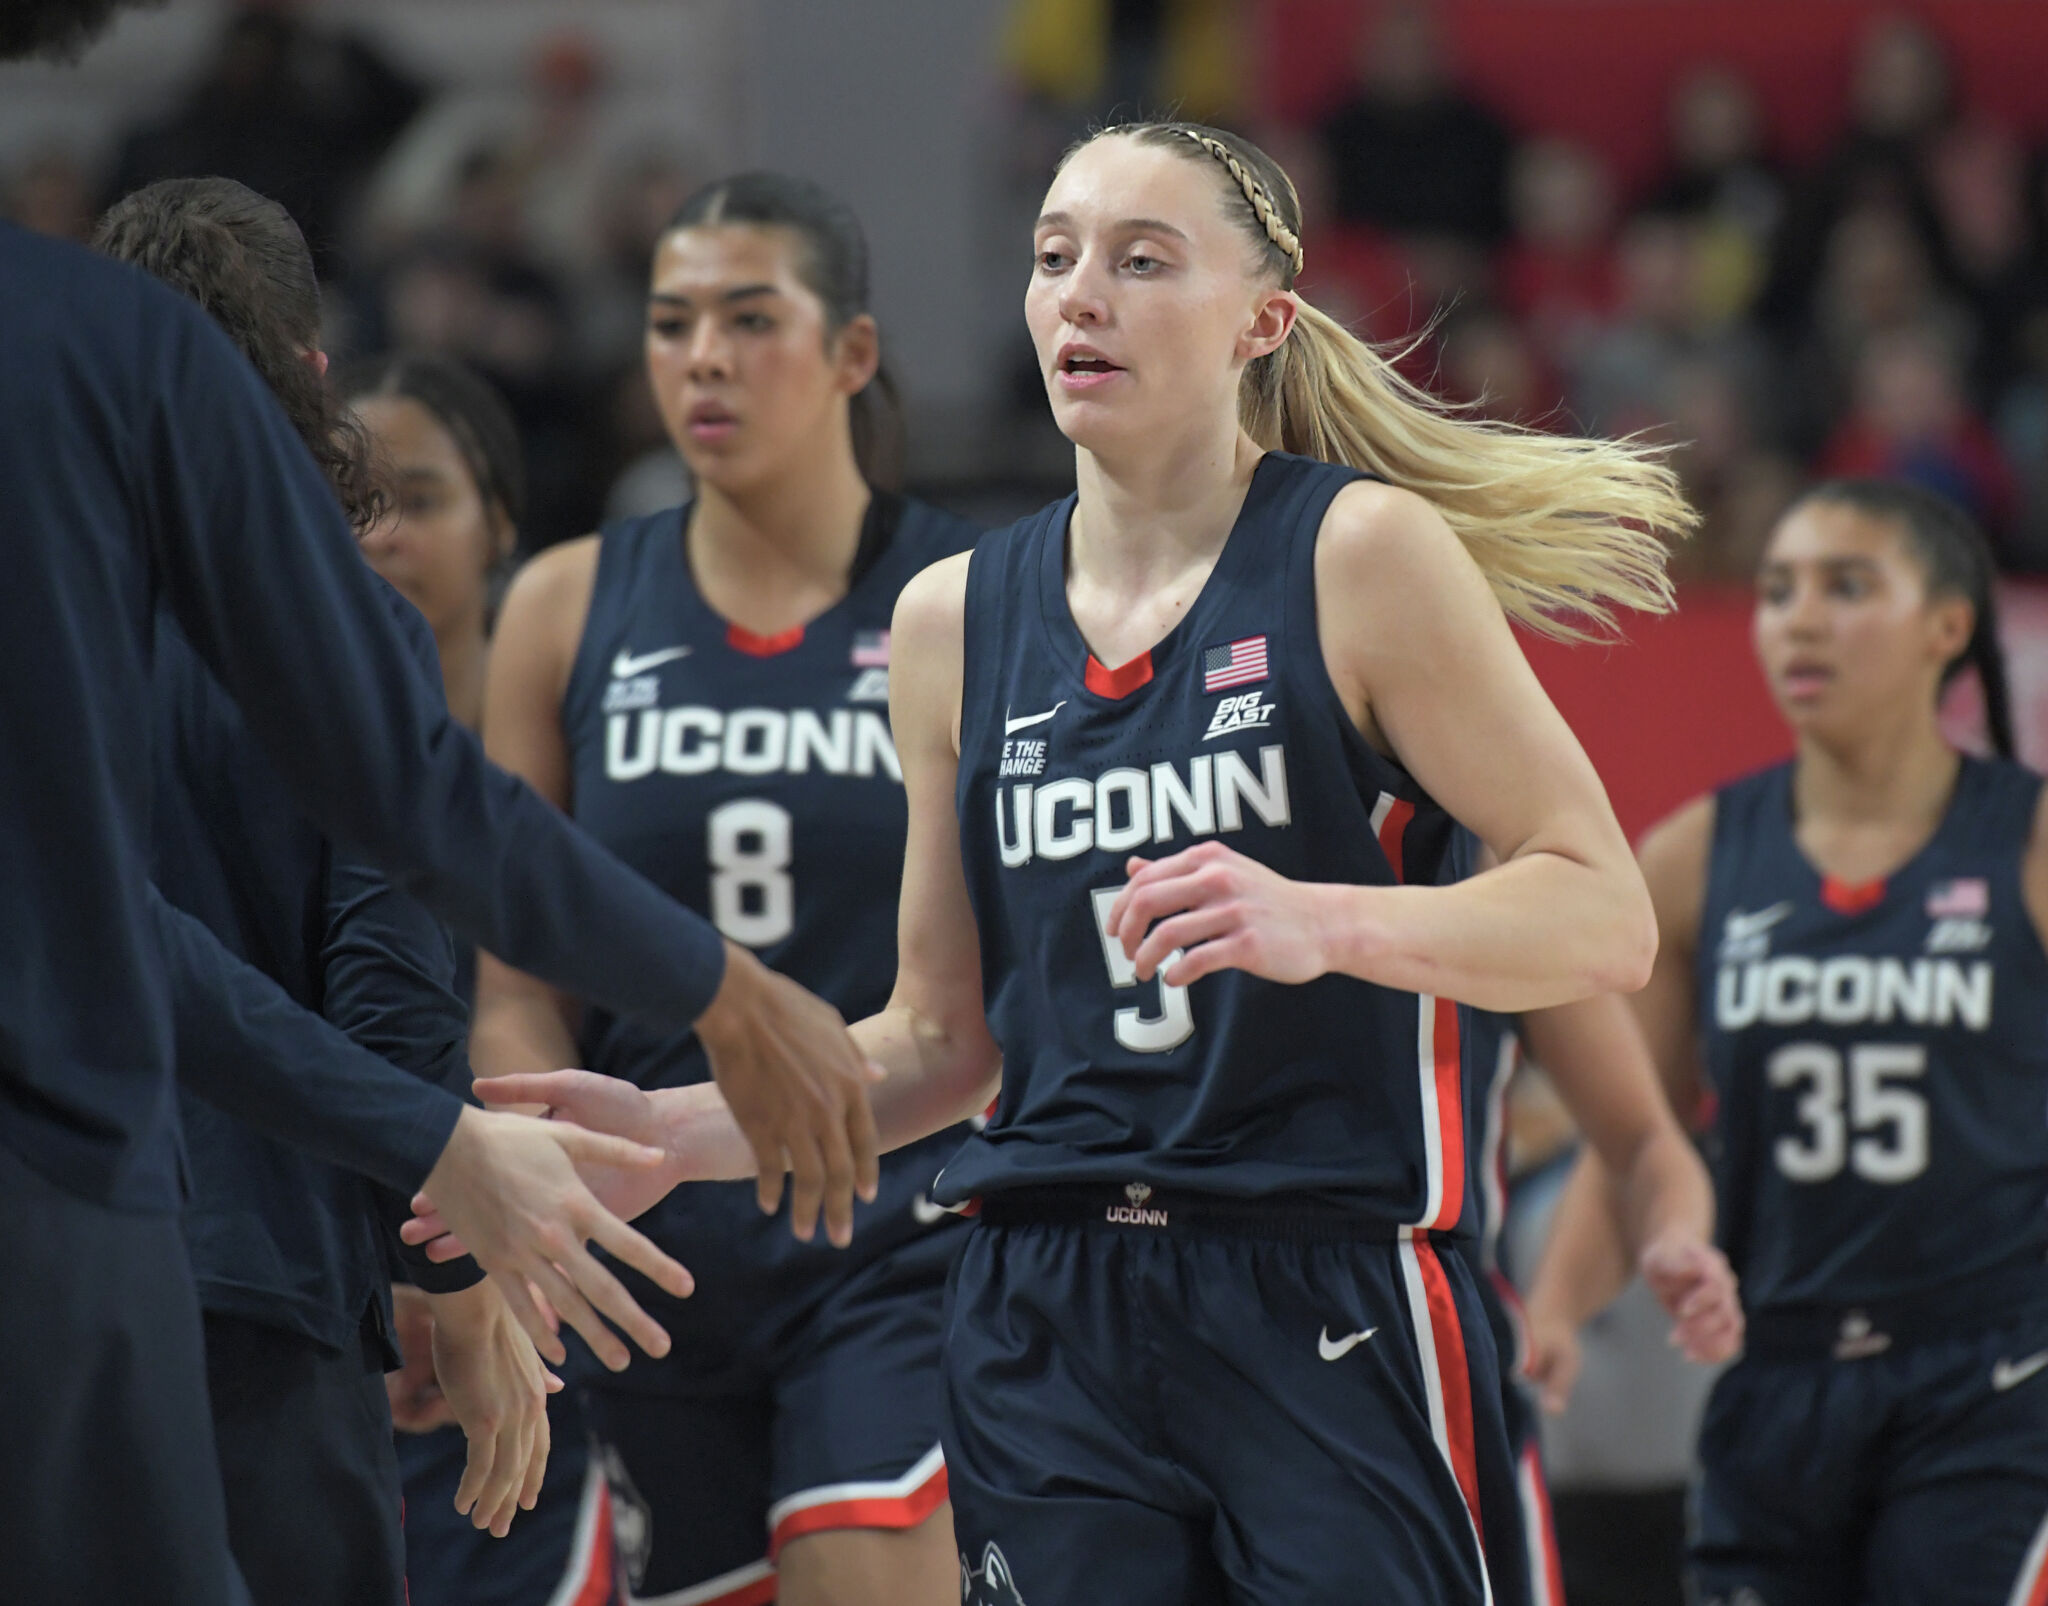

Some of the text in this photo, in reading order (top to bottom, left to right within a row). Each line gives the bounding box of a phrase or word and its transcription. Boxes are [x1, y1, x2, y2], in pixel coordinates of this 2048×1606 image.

[1215, 691, 1263, 716] BIG
[1207, 704, 1276, 731] EAST
[1015, 741, 1047, 758] THE
[999, 758, 1046, 776] HANGE
[996, 745, 1291, 868] UCONN
[708, 798, 794, 946] 8
[1715, 955, 1992, 1031] UCONN
[1766, 1044, 1930, 1184] 35
[1106, 1205, 1168, 1227] UCONN
